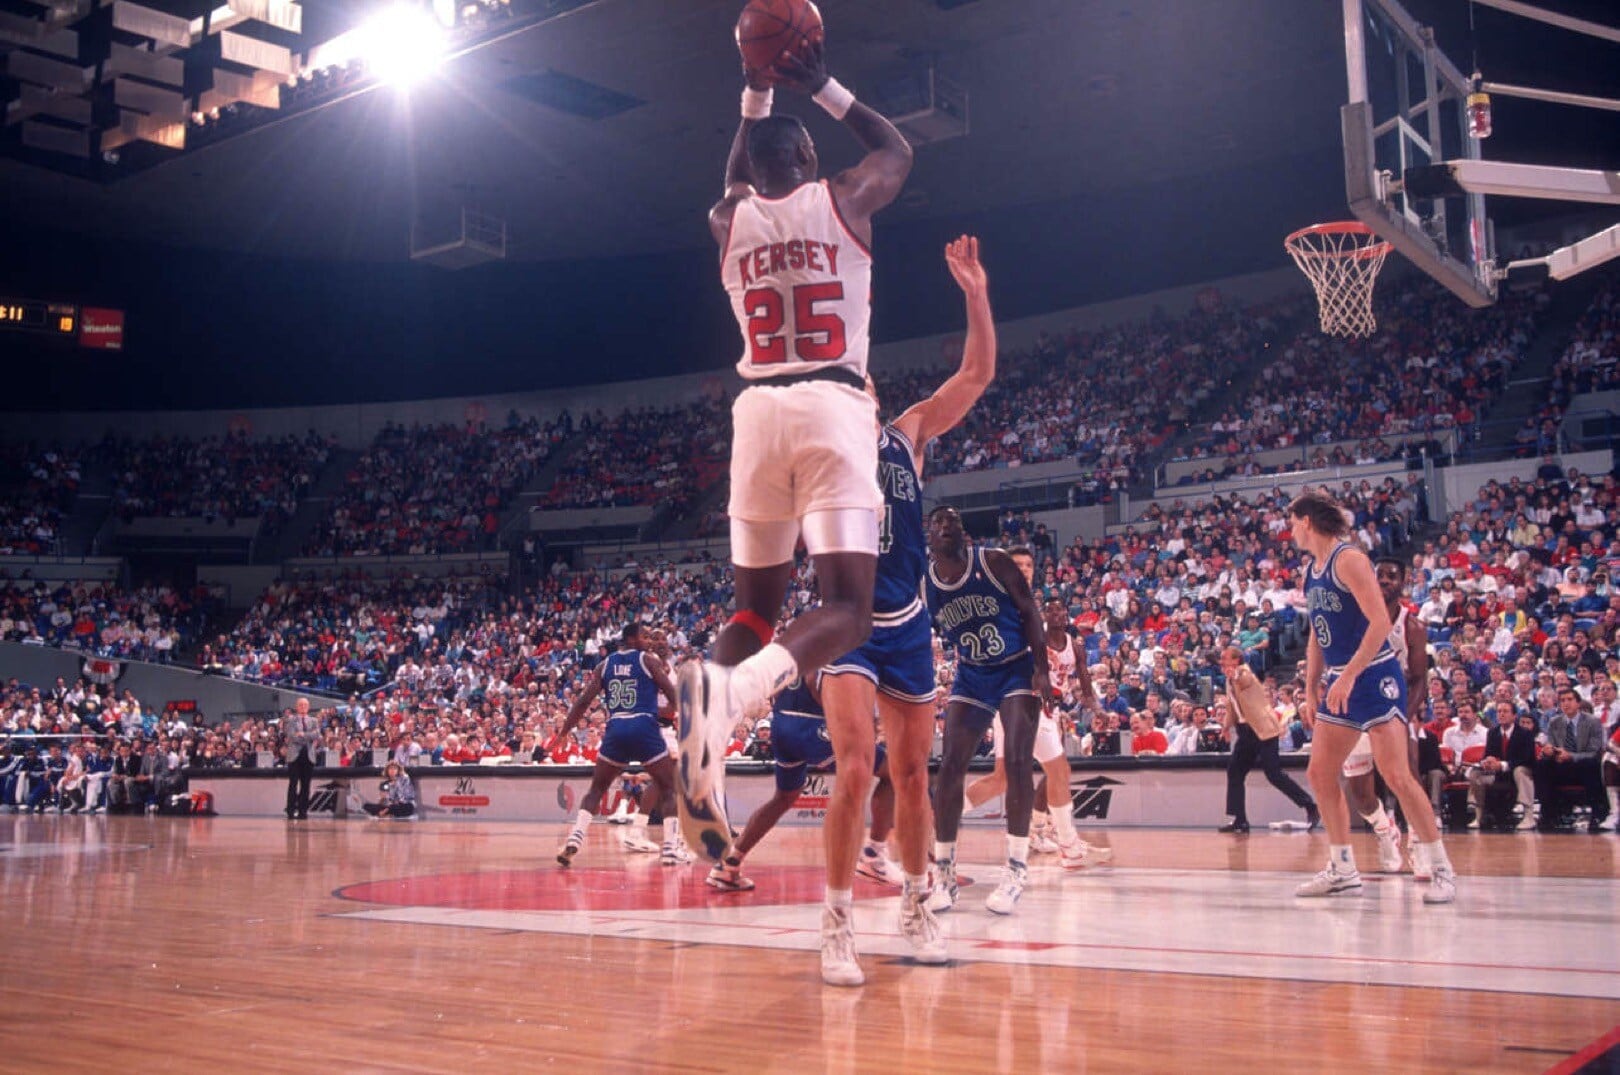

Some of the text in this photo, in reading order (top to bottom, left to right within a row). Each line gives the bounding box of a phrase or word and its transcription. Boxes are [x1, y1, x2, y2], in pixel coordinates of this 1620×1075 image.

[739, 239, 839, 289] KERSEY
[744, 281, 847, 364] 25
[877, 461, 916, 502] VES
[960, 623, 1005, 660] 23
[1315, 615, 1331, 648] 3
[608, 679, 637, 709] 35
